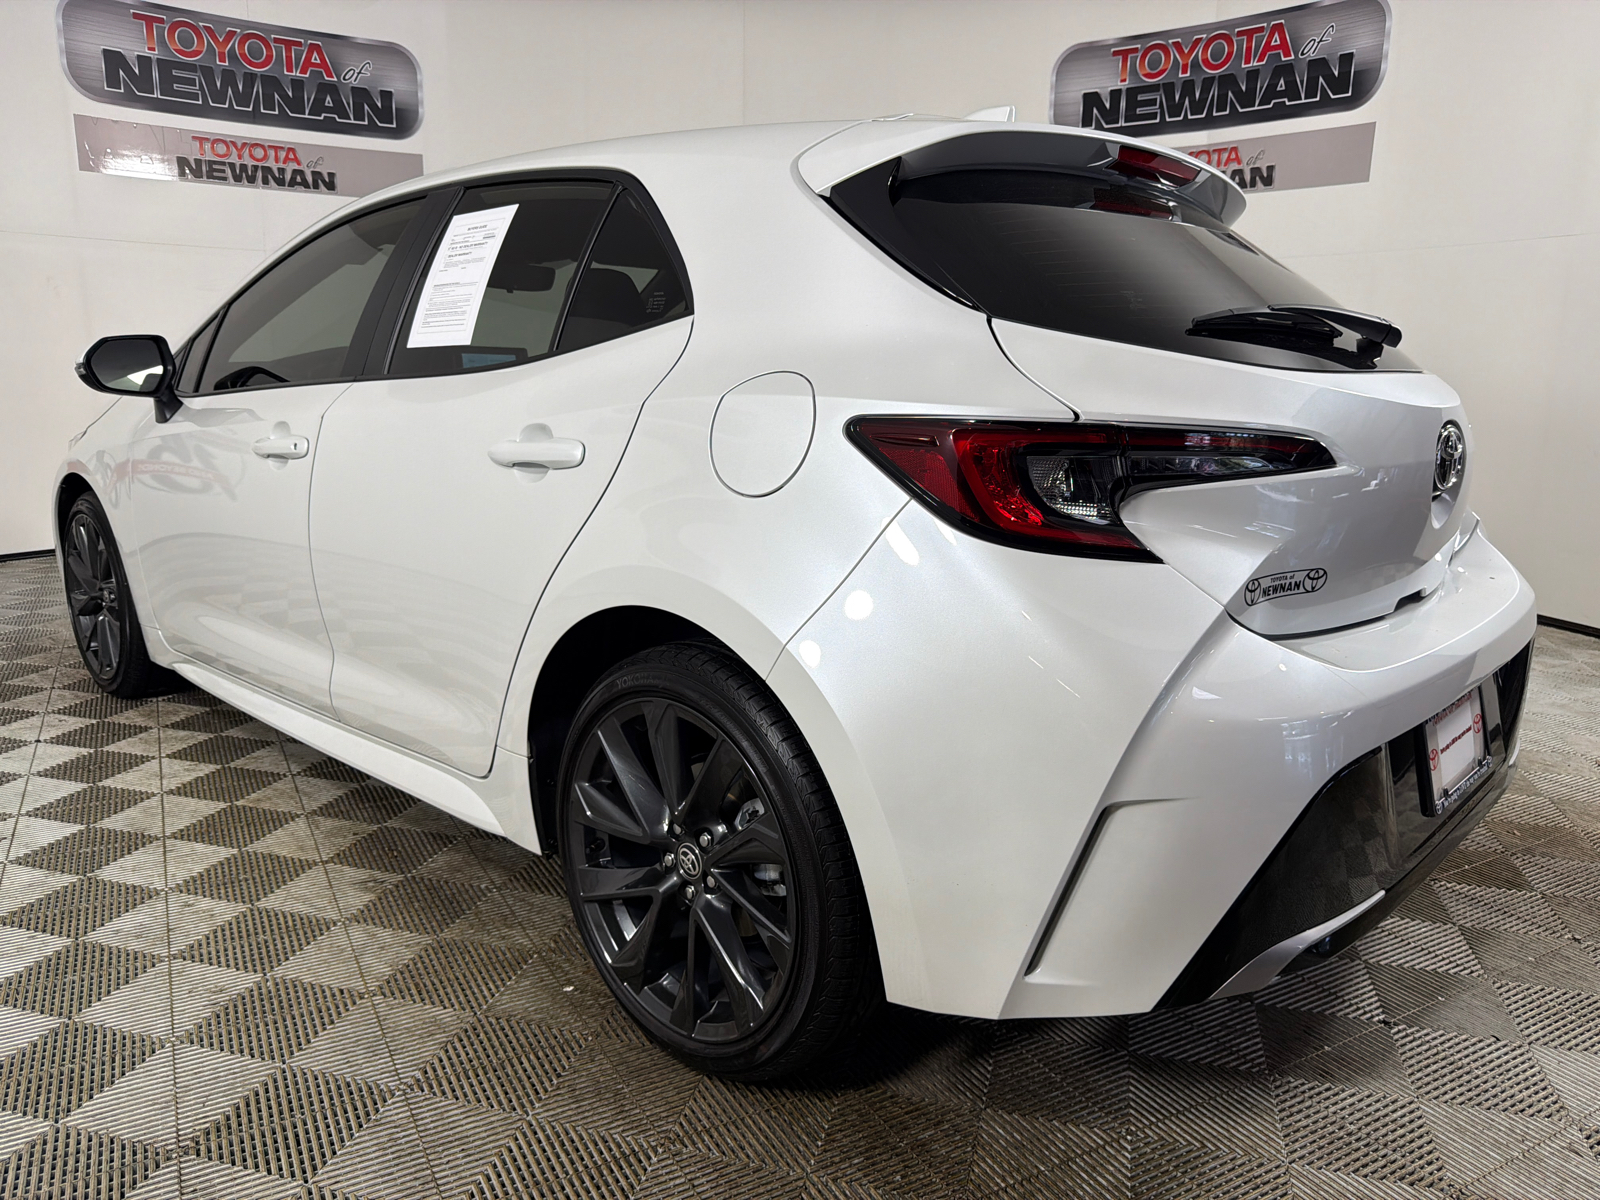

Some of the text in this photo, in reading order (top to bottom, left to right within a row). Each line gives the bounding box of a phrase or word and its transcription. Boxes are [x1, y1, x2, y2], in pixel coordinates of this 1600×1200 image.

[130, 10, 371, 84] TOYOTA of
[1111, 20, 1336, 85] TOYOTA of
[102, 48, 397, 129] NEWNAN
[1081, 51, 1356, 130] NEWNAN
[191, 135, 324, 170] TOYOTA of
[1188, 145, 1266, 170] OTA of
[176, 155, 337, 192] NEWNAN
[1261, 580, 1301, 598] NEWNAN
[1270, 575, 1288, 583] TOYOTA
